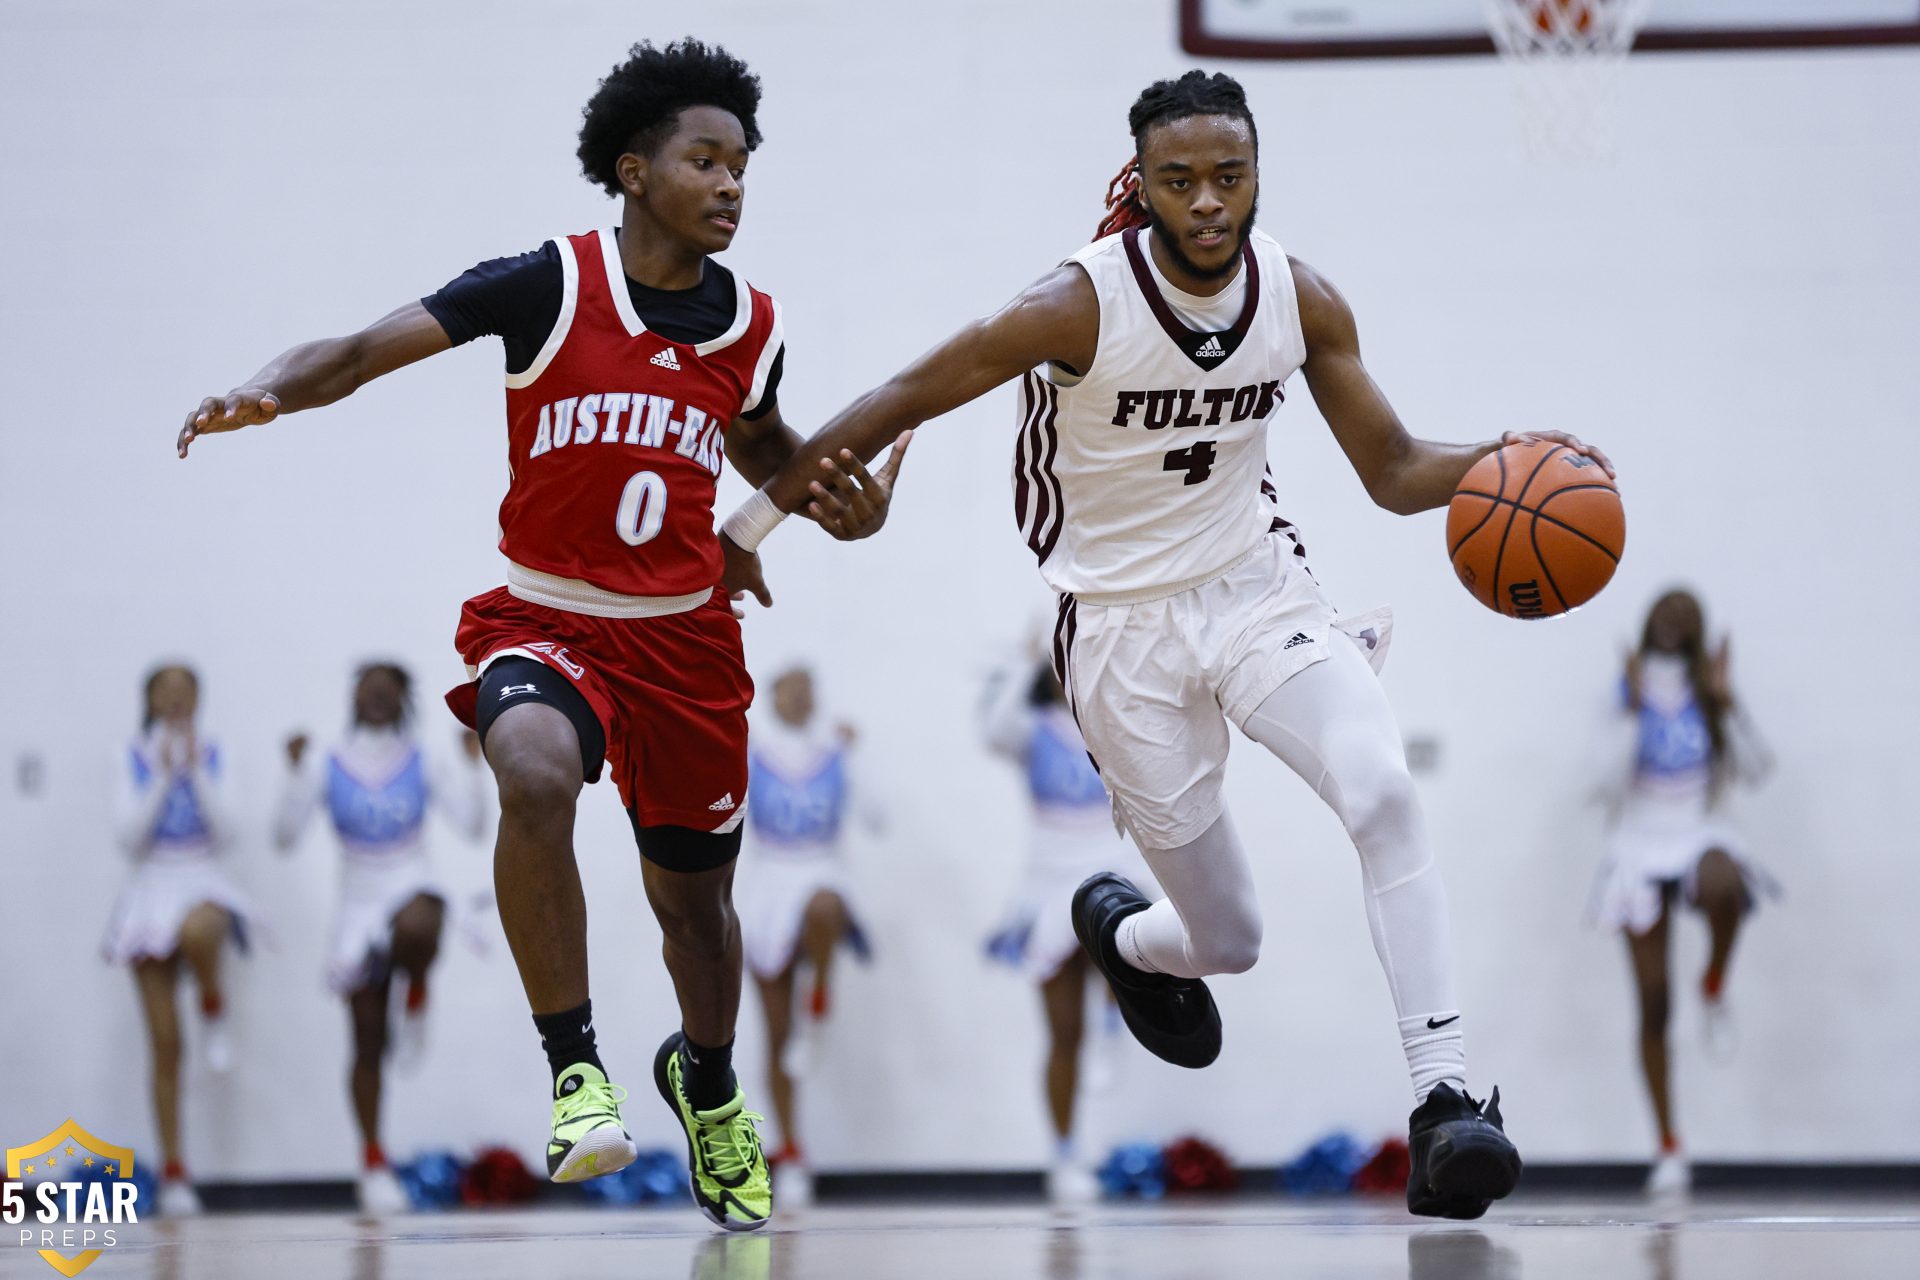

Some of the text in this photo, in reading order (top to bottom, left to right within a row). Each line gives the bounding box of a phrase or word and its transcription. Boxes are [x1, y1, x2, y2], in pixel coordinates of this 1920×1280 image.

[650, 357, 681, 371] adidas
[1195, 349, 1226, 358] adidas
[530, 392, 725, 477] AUSTIN-EAS
[1163, 440, 1217, 486] 4
[615, 470, 668, 547] 0
[1283, 638, 1315, 650] adidas
